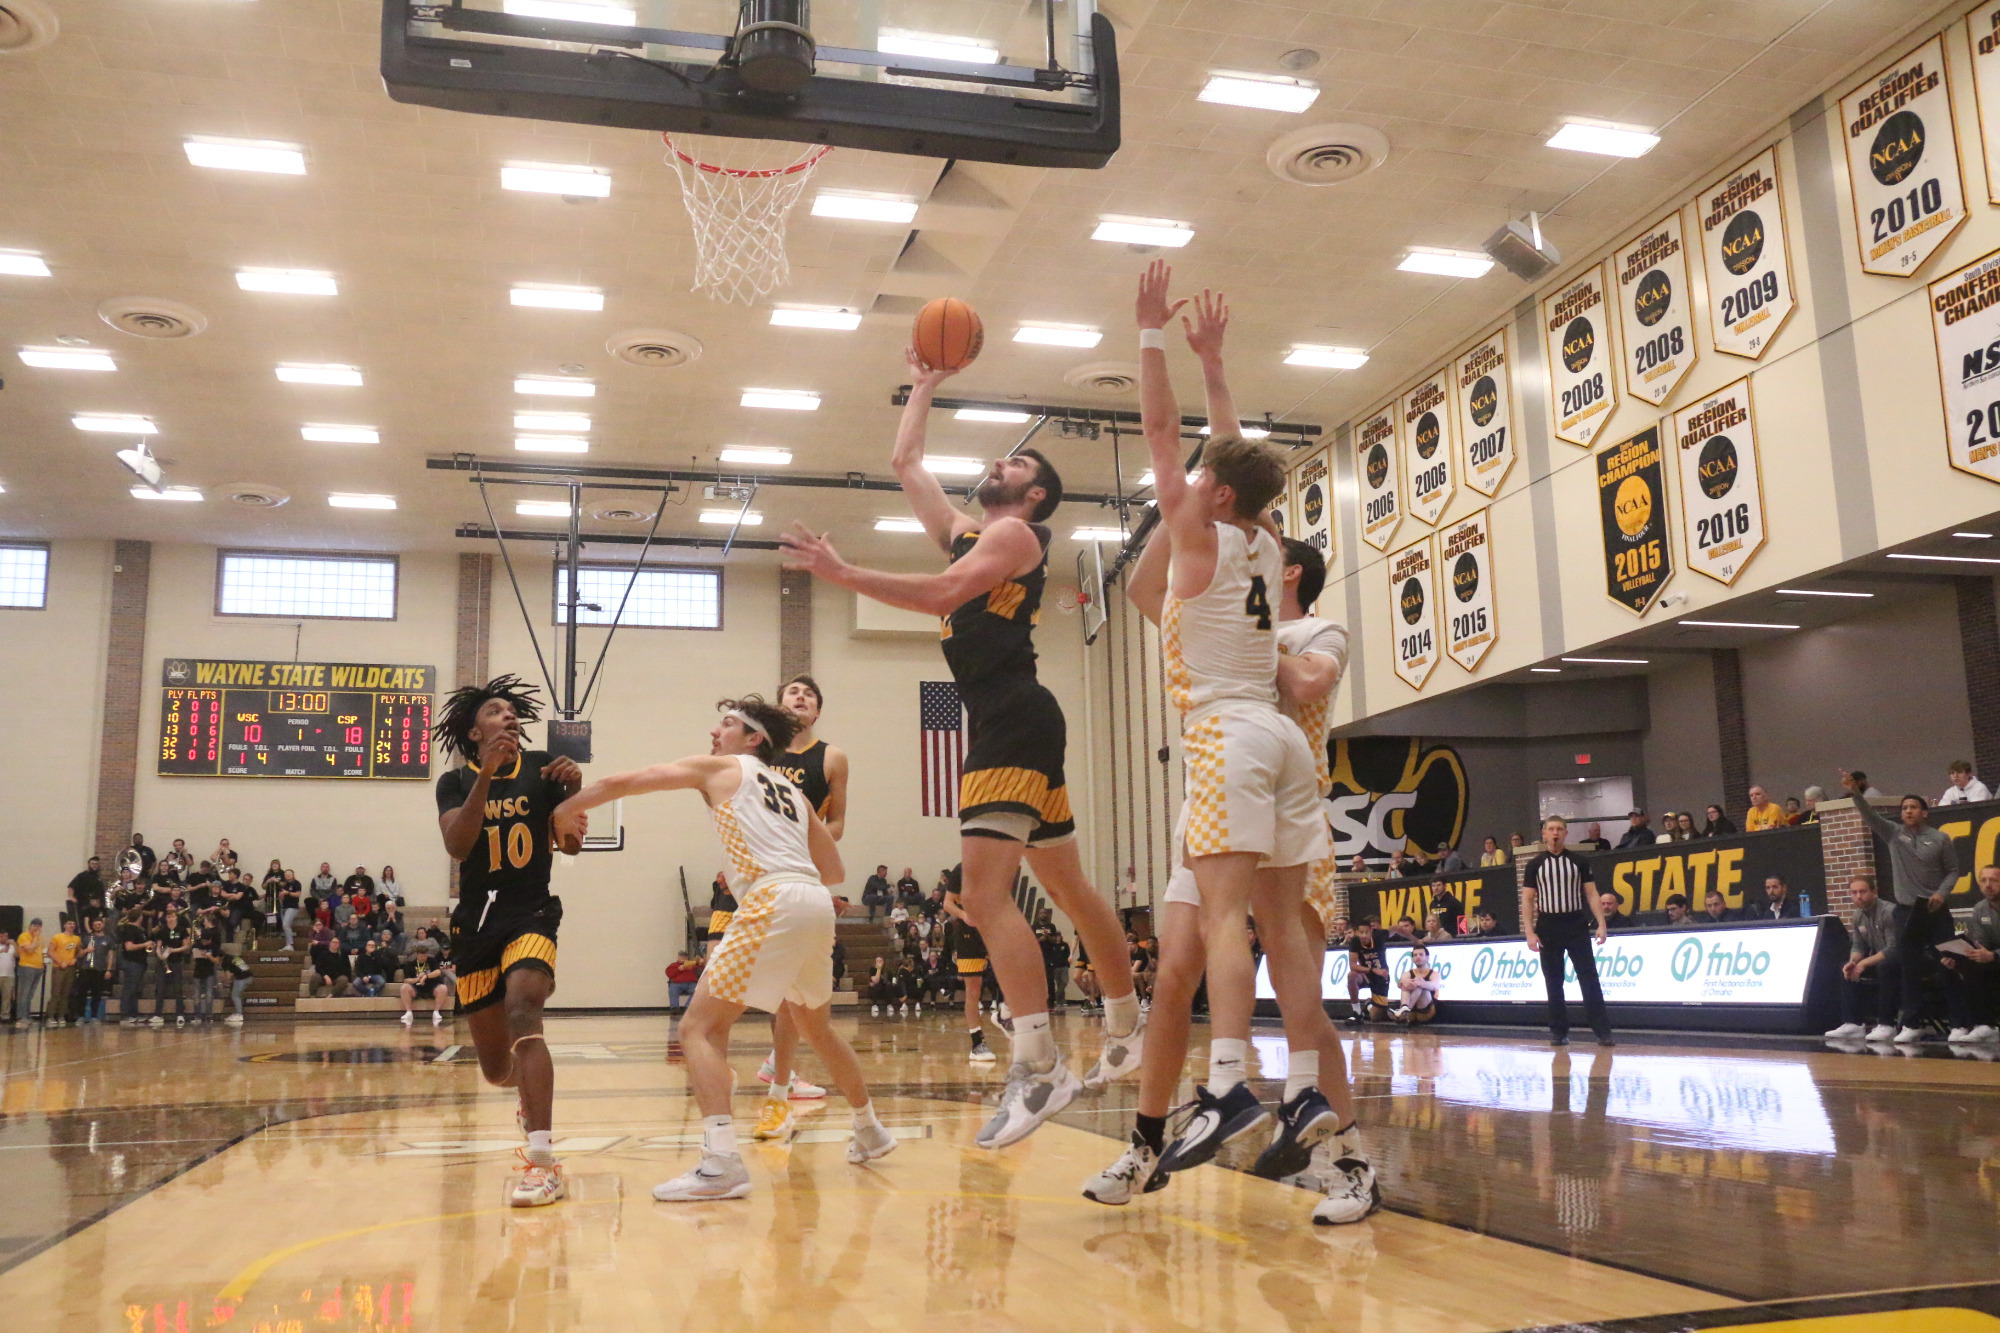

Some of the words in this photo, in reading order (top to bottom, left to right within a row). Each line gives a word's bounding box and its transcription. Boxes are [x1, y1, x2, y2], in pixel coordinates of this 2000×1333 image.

[1858, 62, 1924, 116] REGION
[1850, 70, 1940, 138] QUALIFIER
[1872, 129, 1922, 169] NCAA
[1705, 177, 1773, 231] QUALIFIER
[1711, 169, 1761, 212] REGION
[1870, 177, 1942, 244] 2010
[1626, 230, 1670, 268] REGION
[1723, 227, 1762, 260] NCAA
[1621, 239, 1680, 285] QUALIFIER
[1964, 267, 1982, 282] South
[1554, 283, 1593, 315] REGION
[1636, 283, 1670, 312] NCAA
[1721, 270, 1779, 327] 2009
[1935, 267, 2000, 313] CONFER
[1550, 291, 1601, 332] QUALIFIER
[1564, 332, 1594, 359] NCAA
[1635, 325, 1684, 375] 2008
[1460, 353, 1505, 389] QUALIFIER
[1464, 345, 1496, 374] REGION
[1406, 390, 1445, 423] QUALIFIER
[1411, 383, 1439, 410] REGION
[1471, 390, 1497, 413] NCAA
[1562, 372, 1604, 418] 2008
[1362, 416, 1388, 440] REGION
[1688, 397, 1737, 432] REGION
[1358, 424, 1394, 454] QUALIFIER
[1417, 425, 1439, 447] NCAA
[1681, 407, 1747, 450] QUALIFIER
[1470, 426, 1506, 467] 2007
[1606, 440, 1649, 471] REGION
[1968, 443, 1997, 464] MEN'S
[1299, 466, 1328, 492] QUALIFIER
[1301, 459, 1323, 480] REGION
[1367, 457, 1389, 476] NCAA
[1415, 461, 1447, 498] 2006
[1600, 448, 1660, 488] CHAMPION
[1700, 455, 1736, 481] NCAA
[1305, 498, 1322, 512] NCAA
[1366, 490, 1394, 524] 2006
[1617, 494, 1649, 515] NCAA
[1448, 522, 1479, 547] REGION
[1697, 503, 1749, 550] 2016
[1444, 532, 1486, 561] QUALIFIER
[1392, 558, 1430, 585] QUALIFIER
[1396, 550, 1424, 571] REGION
[1615, 539, 1661, 582] 2015
[1454, 568, 1477, 587] NCAA
[1622, 572, 1656, 592] VOLLEYBALL
[1245, 575, 1272, 631] 4
[1401, 593, 1422, 611] NCAA
[1453, 607, 1487, 642] 2015
[1402, 628, 1432, 661] 2014
[196, 662, 266, 685] WAYNE
[268, 664, 326, 687] STATE
[331, 666, 426, 689] WILDCATS
[168, 690, 184, 699] PLY
[187, 690, 198, 700] FL
[200, 691, 217, 700] PTS
[172, 701, 180, 711] 2
[191, 700, 200, 712] 0
[210, 701, 219, 712] 0
[279, 692, 327, 711] 13:00
[381, 695, 396, 704] PLY
[399, 696, 410, 704] FL
[411, 696, 427, 704] PTS
[168, 712, 179, 722] 10
[190, 712, 199, 724] 0
[210, 713, 219, 724] 0
[237, 713, 259, 722] WSC
[337, 715, 358, 724] CSP
[384, 718, 392, 727] 4
[402, 717, 411, 728] 0
[422, 718, 430, 728] 7
[388, 706, 393, 715] 1
[407, 706, 412, 716] 1
[423, 706, 430, 717] 3
[163, 737, 178, 747] 32
[193, 738, 198, 747] 1
[208, 737, 217, 748] 2
[167, 725, 179, 735] 13
[190, 724, 199, 736] 0
[209, 725, 217, 736] 6
[244, 724, 262, 743] 10
[298, 728, 303, 740] 1
[345, 726, 363, 744] 18
[380, 730, 392, 739] 11
[402, 729, 411, 740] 0
[422, 729, 430, 740] 3
[557, 724, 587, 736] 13:00
[162, 749, 177, 759] 35
[188, 749, 197, 760] 0
[208, 749, 217, 761] 0
[240, 752, 245, 764] 1
[257, 752, 267, 764] 4
[326, 753, 335, 766] 4
[357, 754, 362, 766] 1
[376, 741, 391, 751] 24
[402, 741, 410, 752] 0
[420, 741, 429, 752] 0
[376, 753, 391, 764] 35
[401, 753, 410, 764] 0
[420, 753, 428, 764] 0
[484, 795, 530, 820] WSC
[757, 772, 799, 823] 35
[1318, 790, 1417, 856] SC
[483, 822, 533, 873] 10
[1612, 848, 1745, 917] STATE
[1495, 950, 1539, 979] fnbo
[1706, 941, 1771, 976] fnbo
